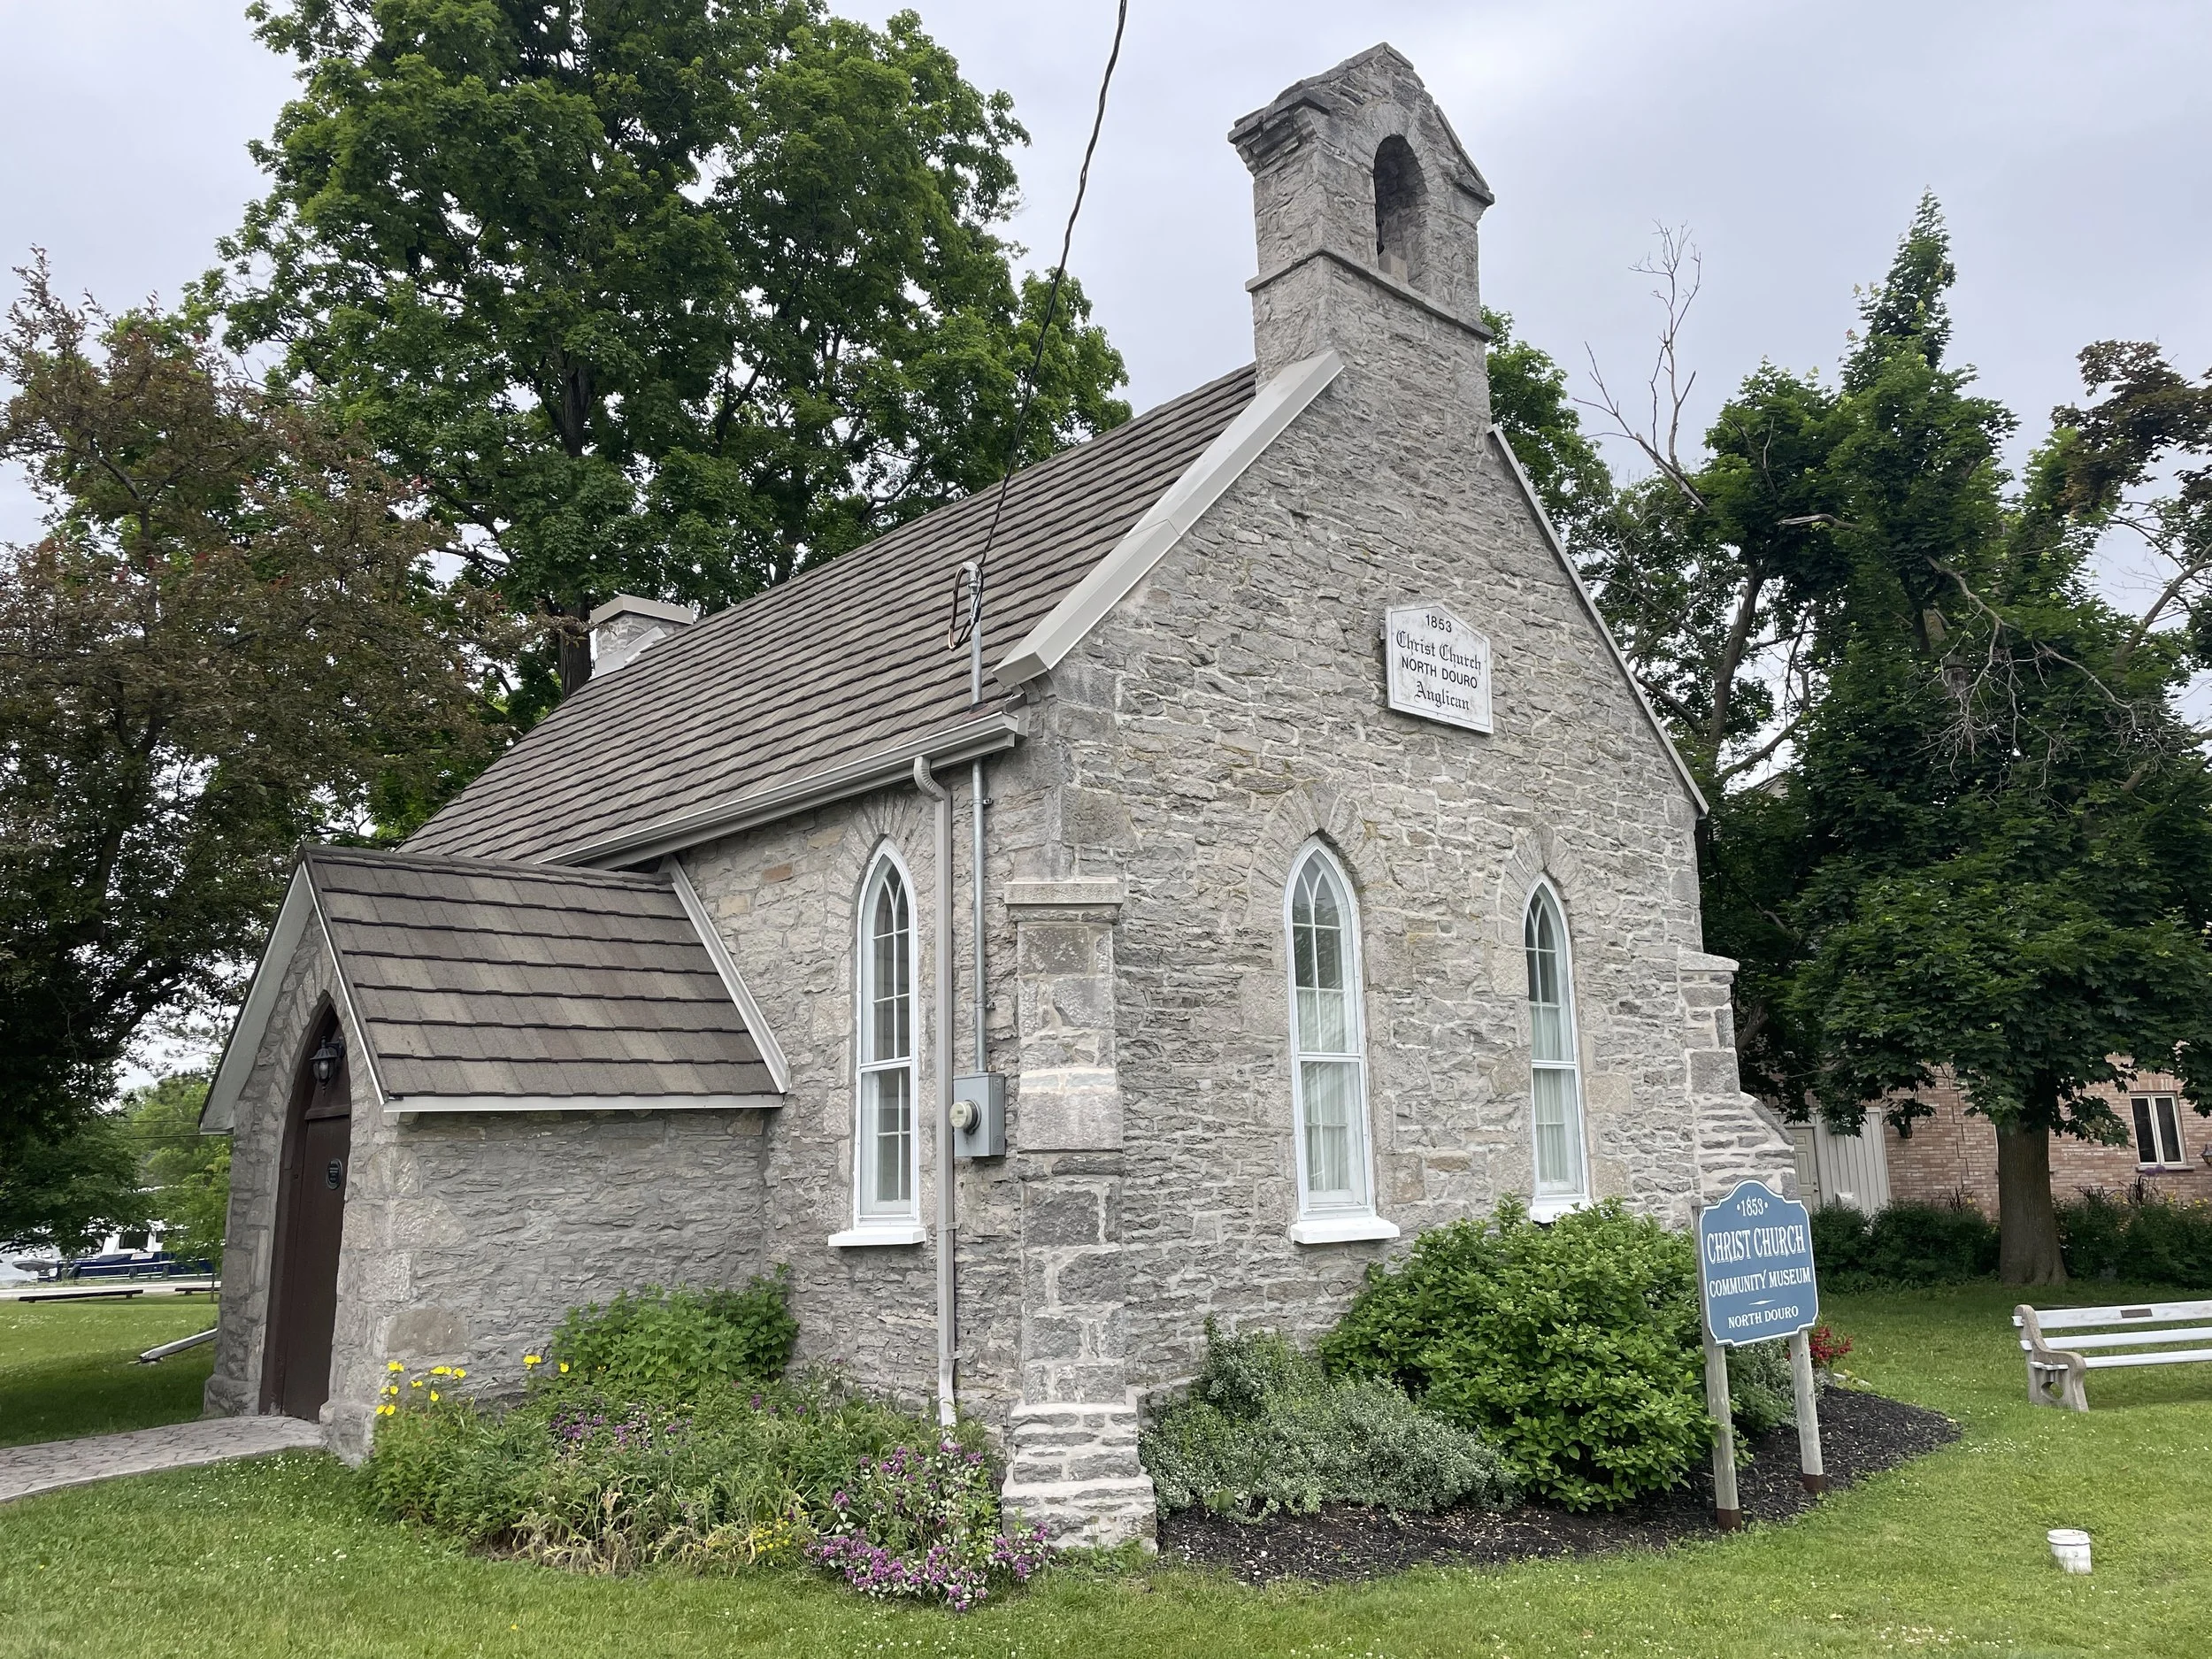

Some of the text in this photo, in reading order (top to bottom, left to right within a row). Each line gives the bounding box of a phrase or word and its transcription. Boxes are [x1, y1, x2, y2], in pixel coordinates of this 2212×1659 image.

[1425, 614, 1452, 633] 1853
[1396, 630, 1481, 675] Christ Church
[1402, 657, 1477, 688] NORTH DOURO
[1414, 681, 1470, 710] Anglican
[1708, 1225, 1806, 1264] CHRIST CHURCH
[1709, 1267, 1811, 1298] COMMUNITY MUSEUM
[1728, 1306, 1798, 1329] NORTH DOURO
